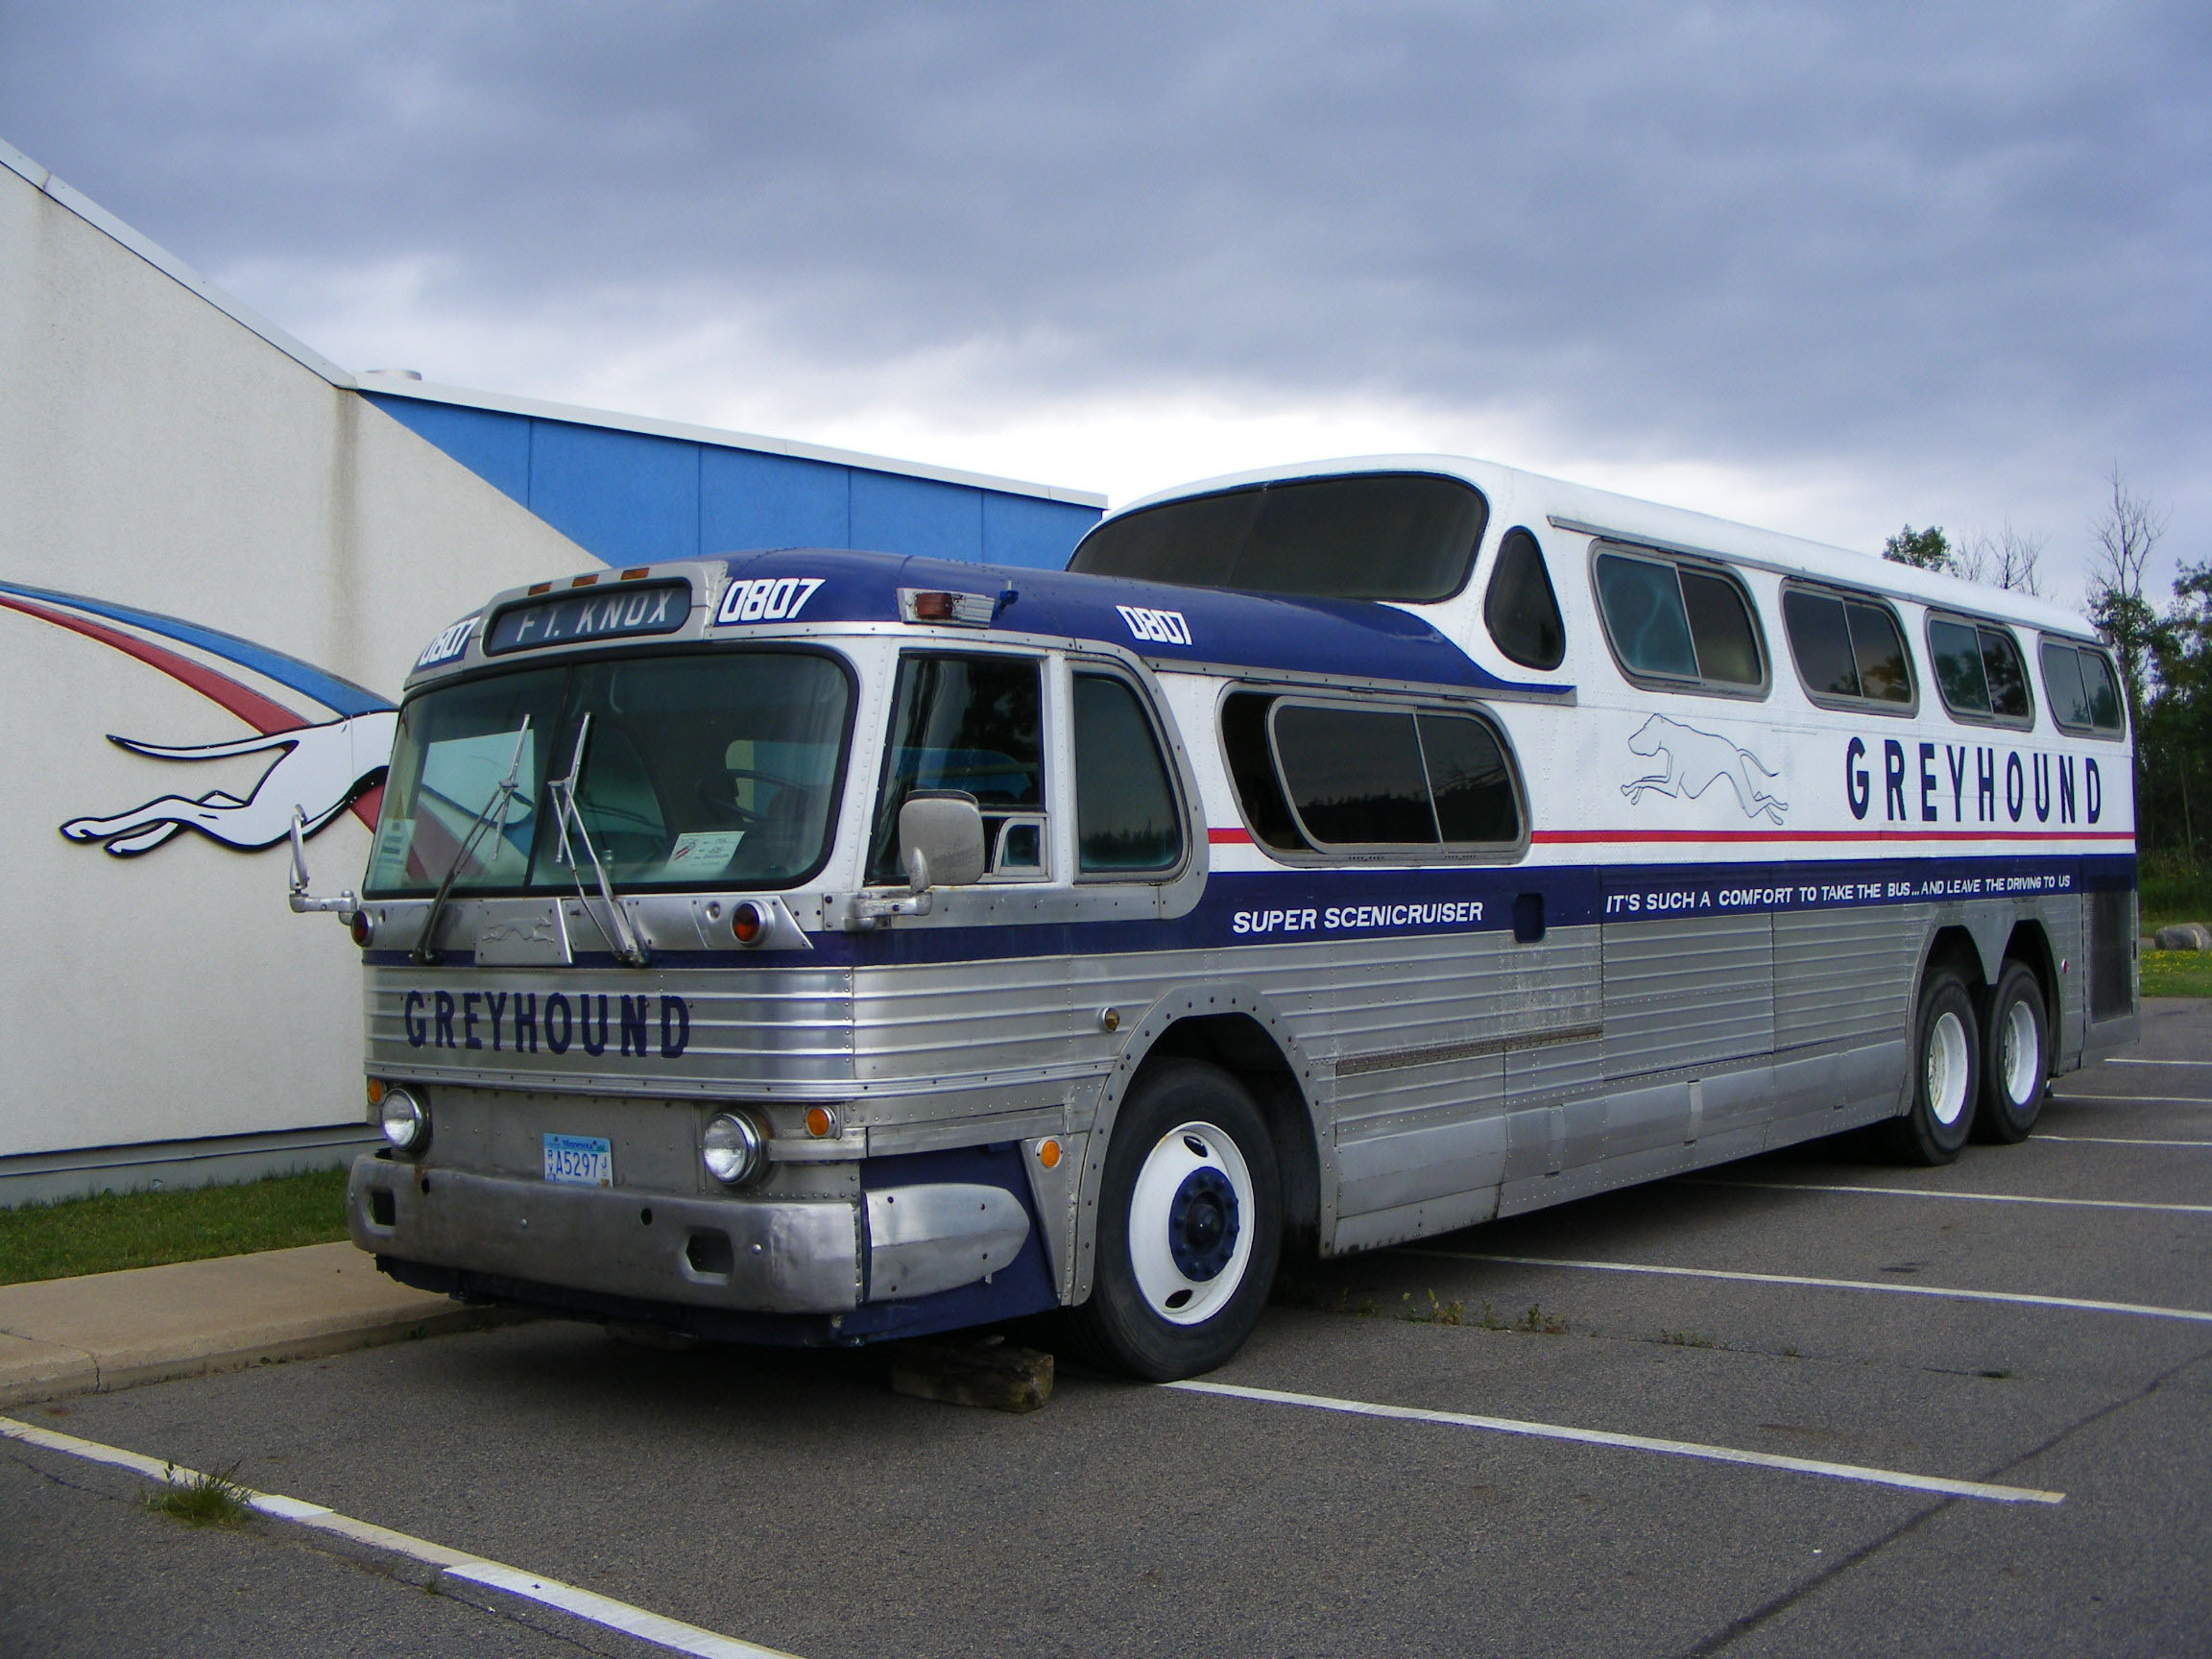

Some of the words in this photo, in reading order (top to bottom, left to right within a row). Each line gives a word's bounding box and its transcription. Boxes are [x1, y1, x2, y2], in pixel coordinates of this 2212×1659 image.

[513, 608, 561, 643] FT.
[575, 588, 673, 634] KNOX
[718, 578, 826, 623] 0807
[419, 615, 481, 666] 0807
[1116, 605, 1192, 646] 0807
[1846, 736, 2102, 825] GREYHOUND
[1606, 894, 1641, 913] IT'S
[1646, 891, 1695, 910] SUCH
[1699, 891, 1711, 907] A
[1719, 887, 1793, 906] COMFORT
[1799, 886, 1817, 902] TO
[1821, 884, 1854, 901] TAKE
[1857, 882, 1882, 899] THE
[1946, 878, 1981, 894] LEAVE
[1985, 877, 2006, 892] THE
[2007, 876, 2042, 891] DRIVING
[2044, 875, 2056, 888] TO
[2058, 875, 2071, 887] US
[1232, 908, 1316, 934] SUPER
[1324, 902, 1483, 929] SCENICRUISER
[404, 990, 690, 1058] GREYHOUND
[556, 1150, 599, 1178] A5297
